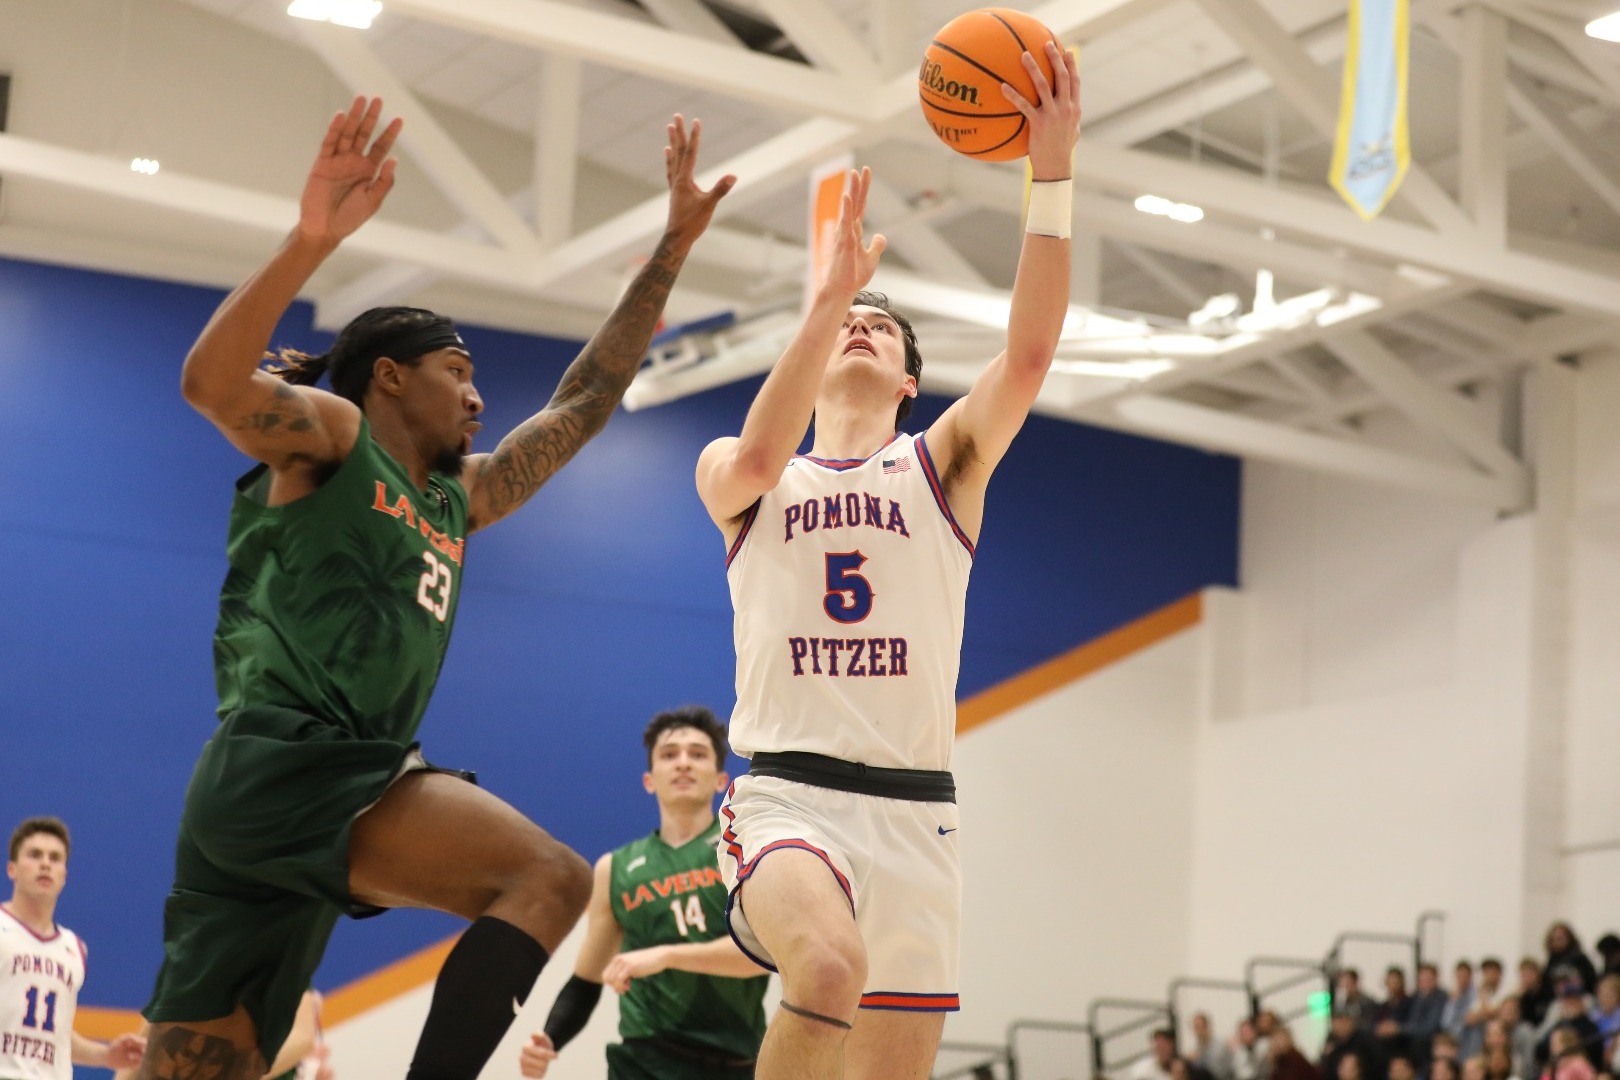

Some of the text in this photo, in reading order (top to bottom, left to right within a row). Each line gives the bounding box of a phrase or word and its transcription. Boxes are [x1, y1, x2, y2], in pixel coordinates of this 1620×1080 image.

[371, 479, 417, 530] LA
[784, 491, 910, 544] POMONA
[417, 550, 453, 623] 23
[823, 548, 876, 625] 5
[788, 636, 908, 677] PITZER
[622, 866, 723, 911] LA VERN
[669, 894, 707, 936] 14
[12, 954, 74, 992] POMONA
[22, 985, 57, 1033] 11
